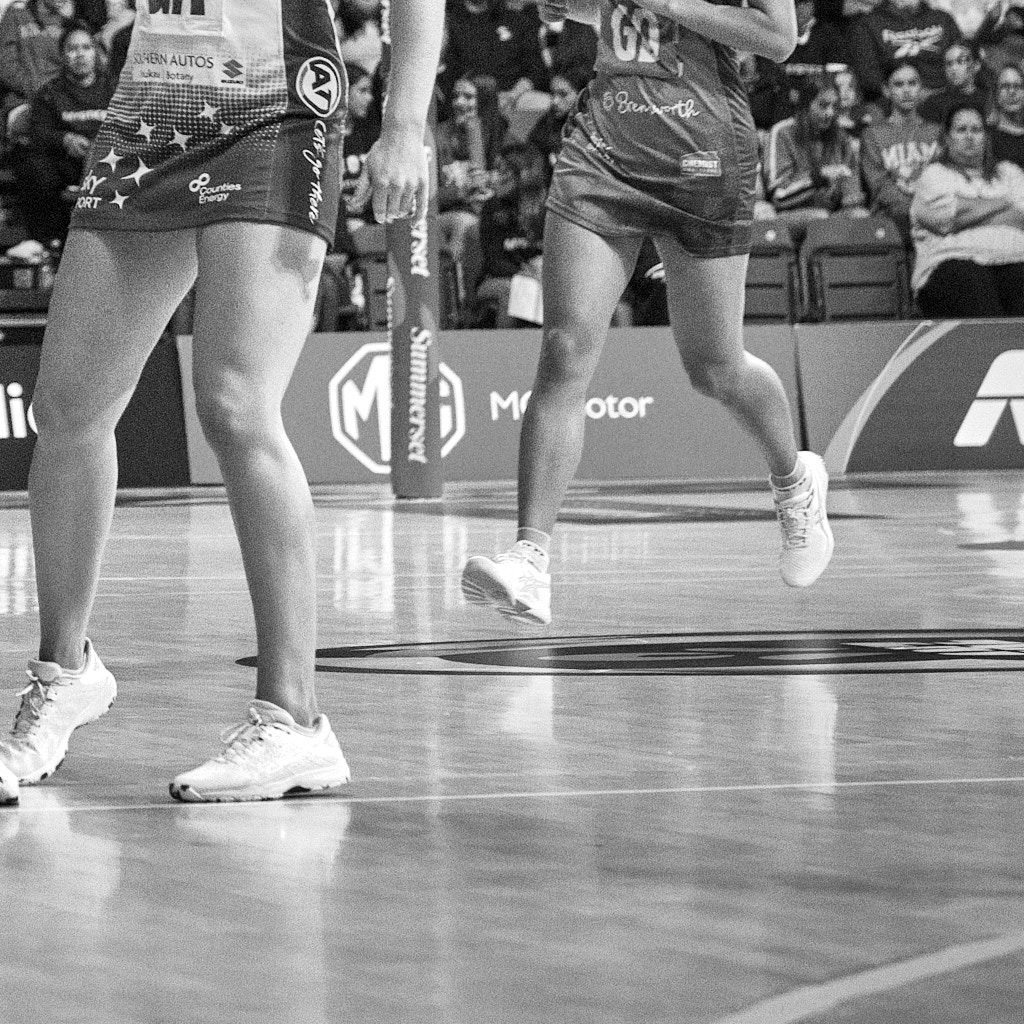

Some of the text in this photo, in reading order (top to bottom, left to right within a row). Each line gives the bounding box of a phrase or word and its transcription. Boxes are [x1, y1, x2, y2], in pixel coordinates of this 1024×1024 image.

[170, 54, 214, 69] AUTOS
[199, 182, 242, 196] Counties
[198, 193, 229, 205] Energy
[584, 394, 655, 419] otor
